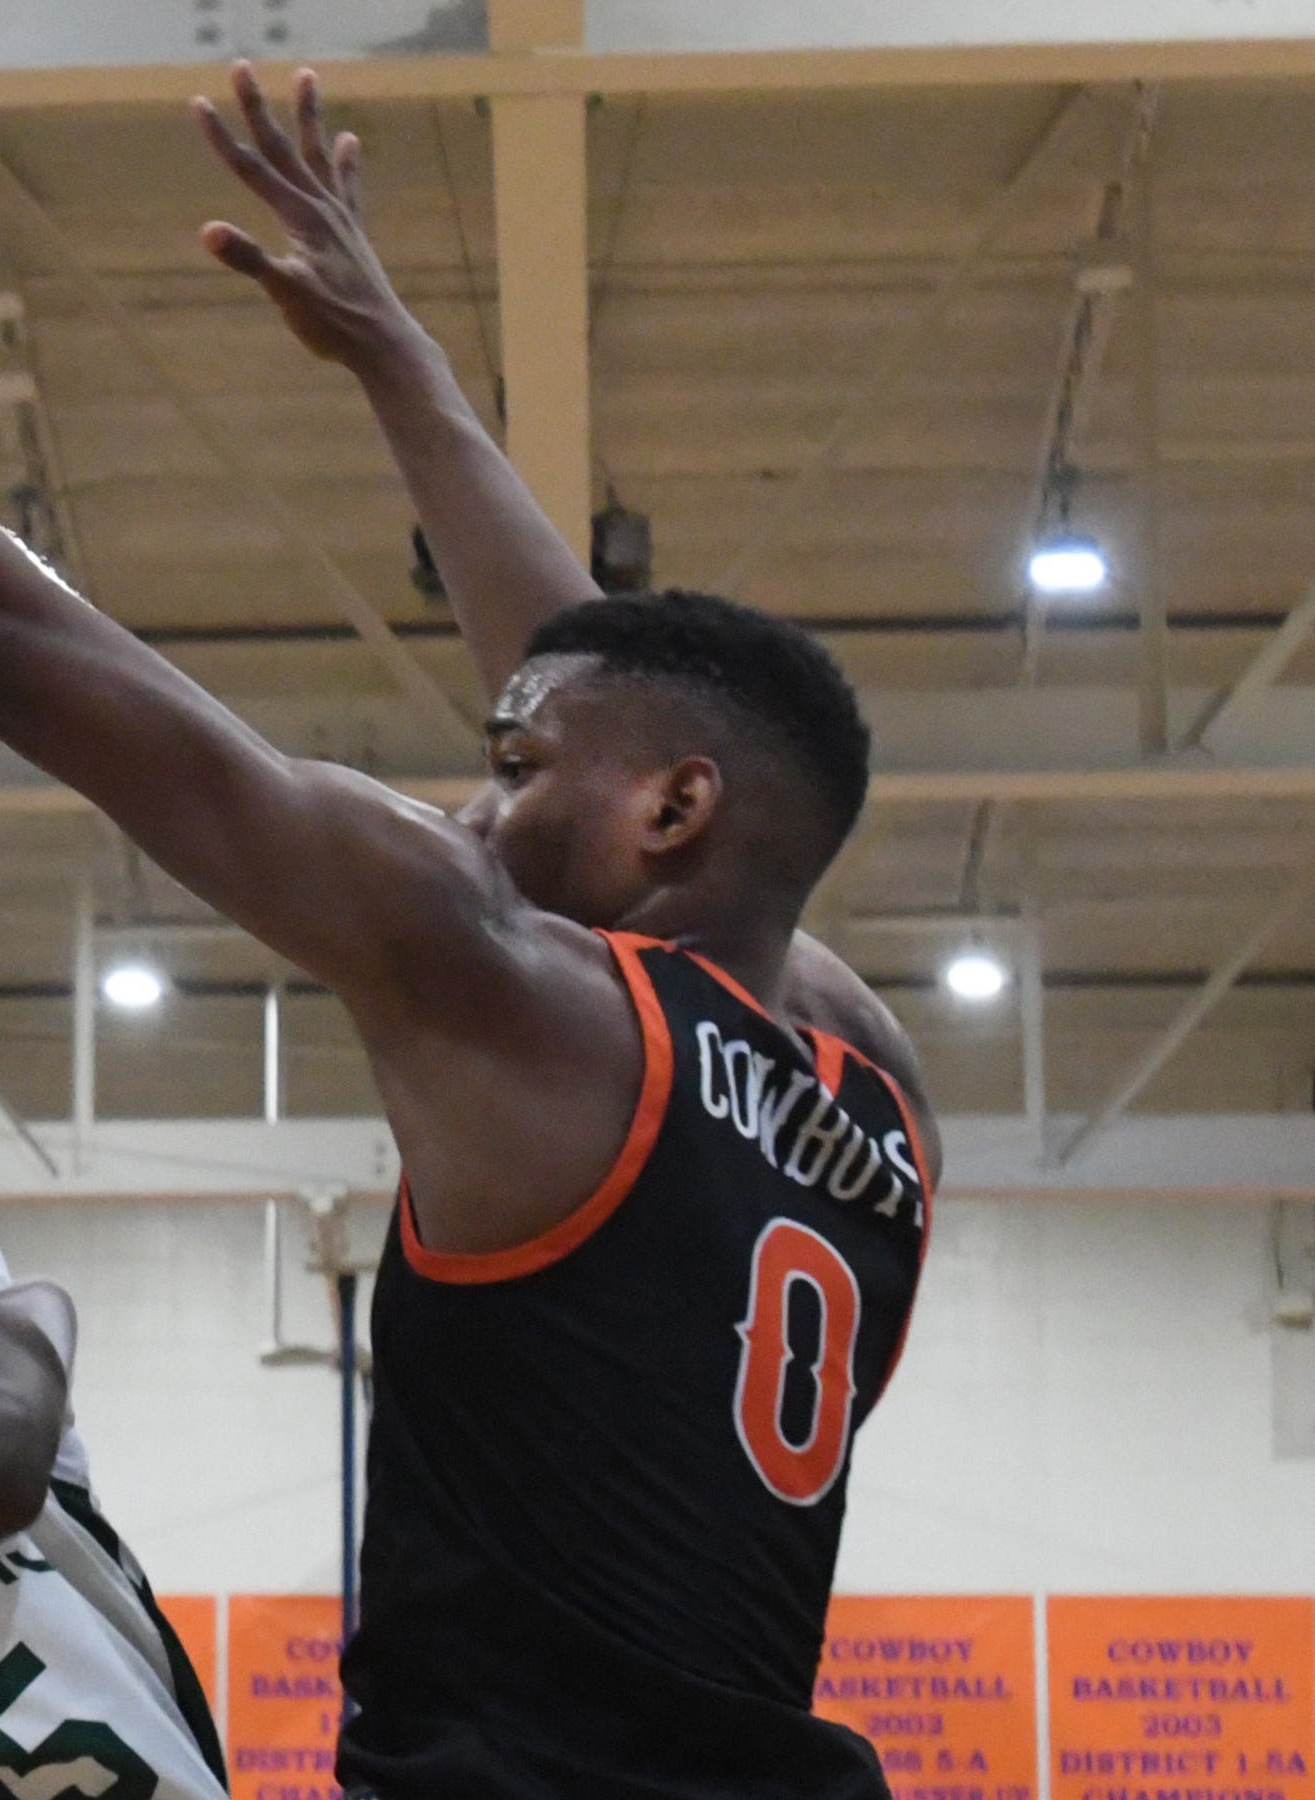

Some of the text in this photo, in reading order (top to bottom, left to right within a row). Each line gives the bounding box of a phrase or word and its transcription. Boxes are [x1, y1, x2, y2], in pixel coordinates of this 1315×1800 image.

[733, 1216, 861, 1507] 0
[831, 1638, 972, 1662] COWBOY
[1108, 1638, 1254, 1664] COWBOY
[815, 1677, 1013, 1701] ASKETBALL
[1072, 1677, 1290, 1702] BASKETBALL
[1060, 1750, 1219, 1776] DISTRICT
